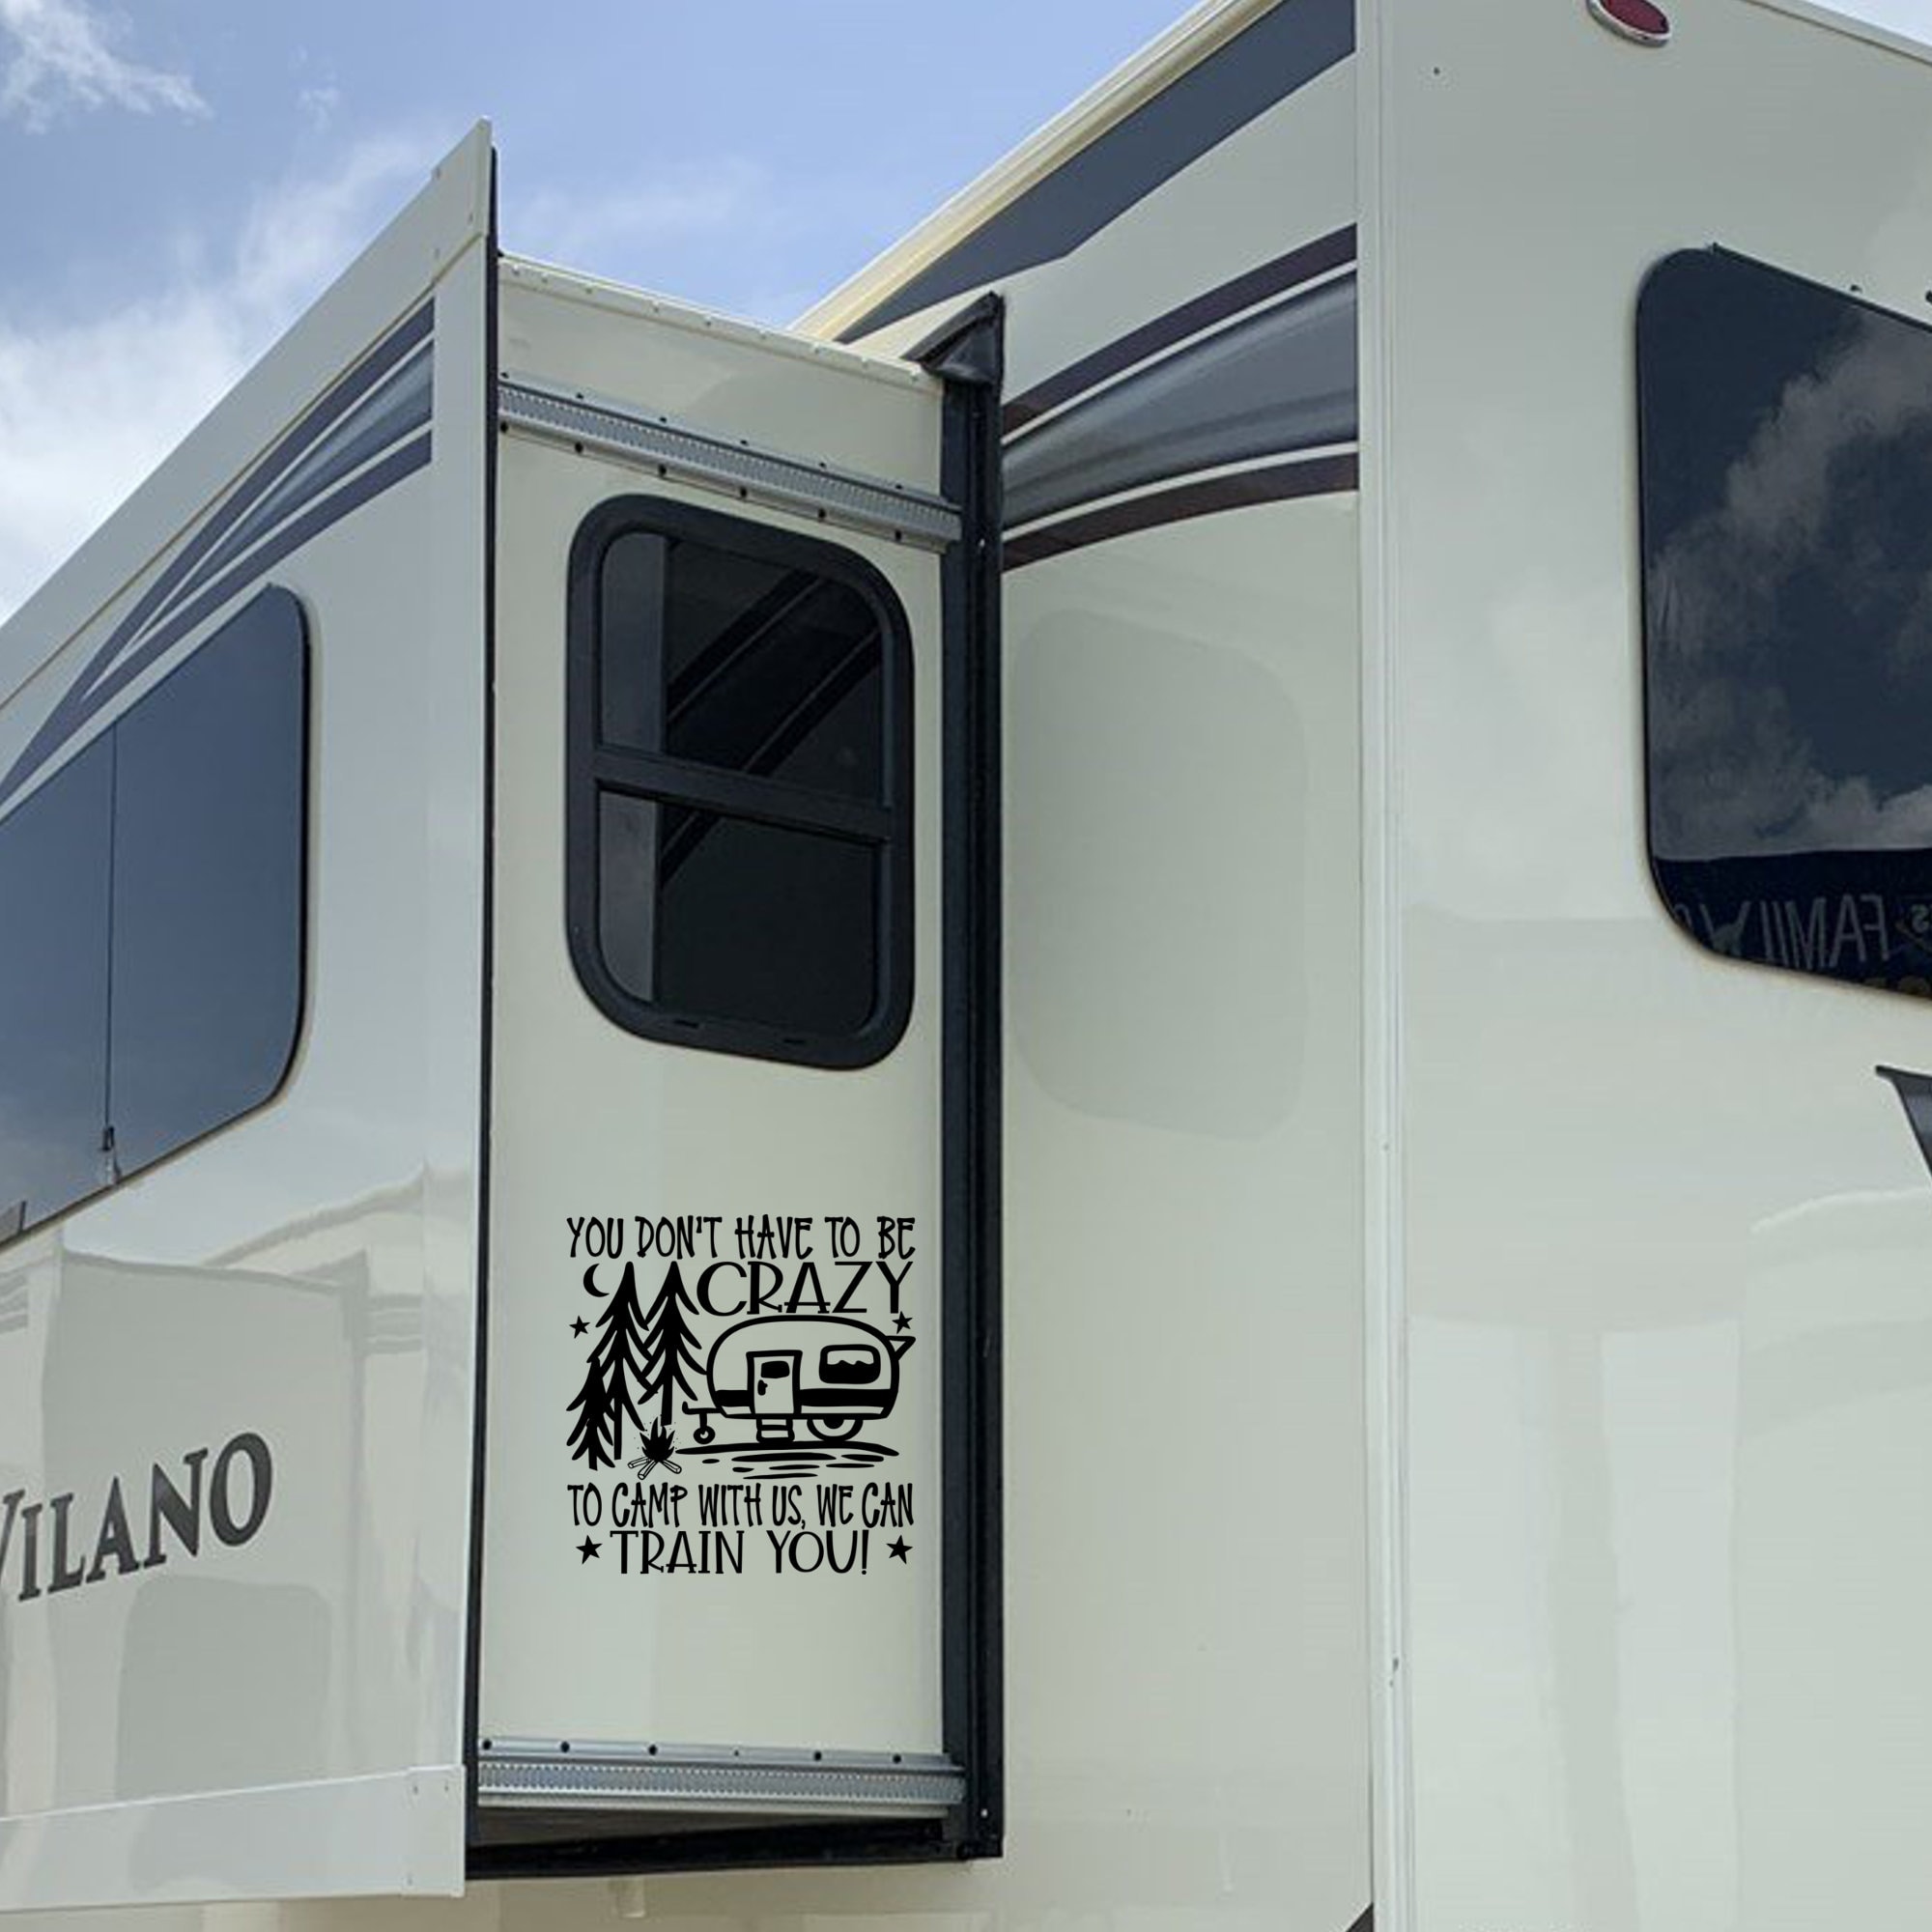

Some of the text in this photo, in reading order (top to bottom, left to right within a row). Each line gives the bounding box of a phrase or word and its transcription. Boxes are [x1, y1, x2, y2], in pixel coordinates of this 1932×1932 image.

[566, 1213, 917, 1261] YOU DON'T HAVE TO BE
[696, 1261, 914, 1317] CRAZY
[566, 1481, 915, 1531] TO CAMP WITH US, WE CAN
[609, 1528, 870, 1577] TRAIN YOU!
